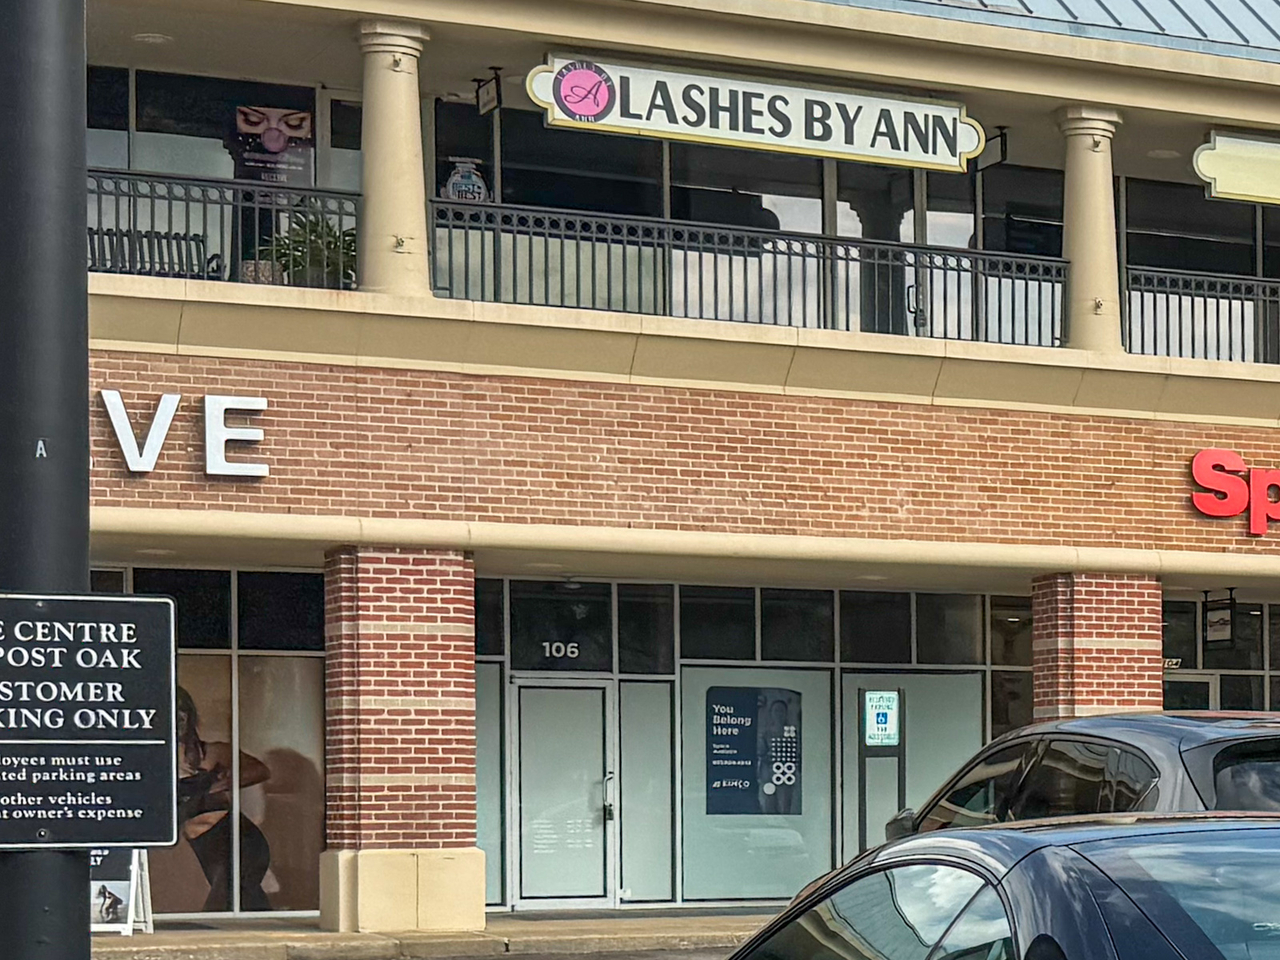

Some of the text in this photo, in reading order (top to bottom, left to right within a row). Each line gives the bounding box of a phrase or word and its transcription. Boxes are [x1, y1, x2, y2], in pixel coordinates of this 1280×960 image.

[619, 75, 958, 158] LASHES BY ANN
[35, 440, 47, 457] A
[14, 620, 137, 643] CENTRE
[542, 641, 579, 658] 106
[76, 647, 142, 669] OAK
[713, 704, 734, 714] You
[73, 708, 157, 729] ONLY
[713, 715, 752, 726] Belong
[713, 725, 740, 735] Here
[0, 755, 122, 768] oyees must use
[0, 768, 142, 783] ted parking areas
[0, 792, 112, 805] other vehicles
[12, 806, 73, 819] owner's
[78, 809, 143, 821] expense
